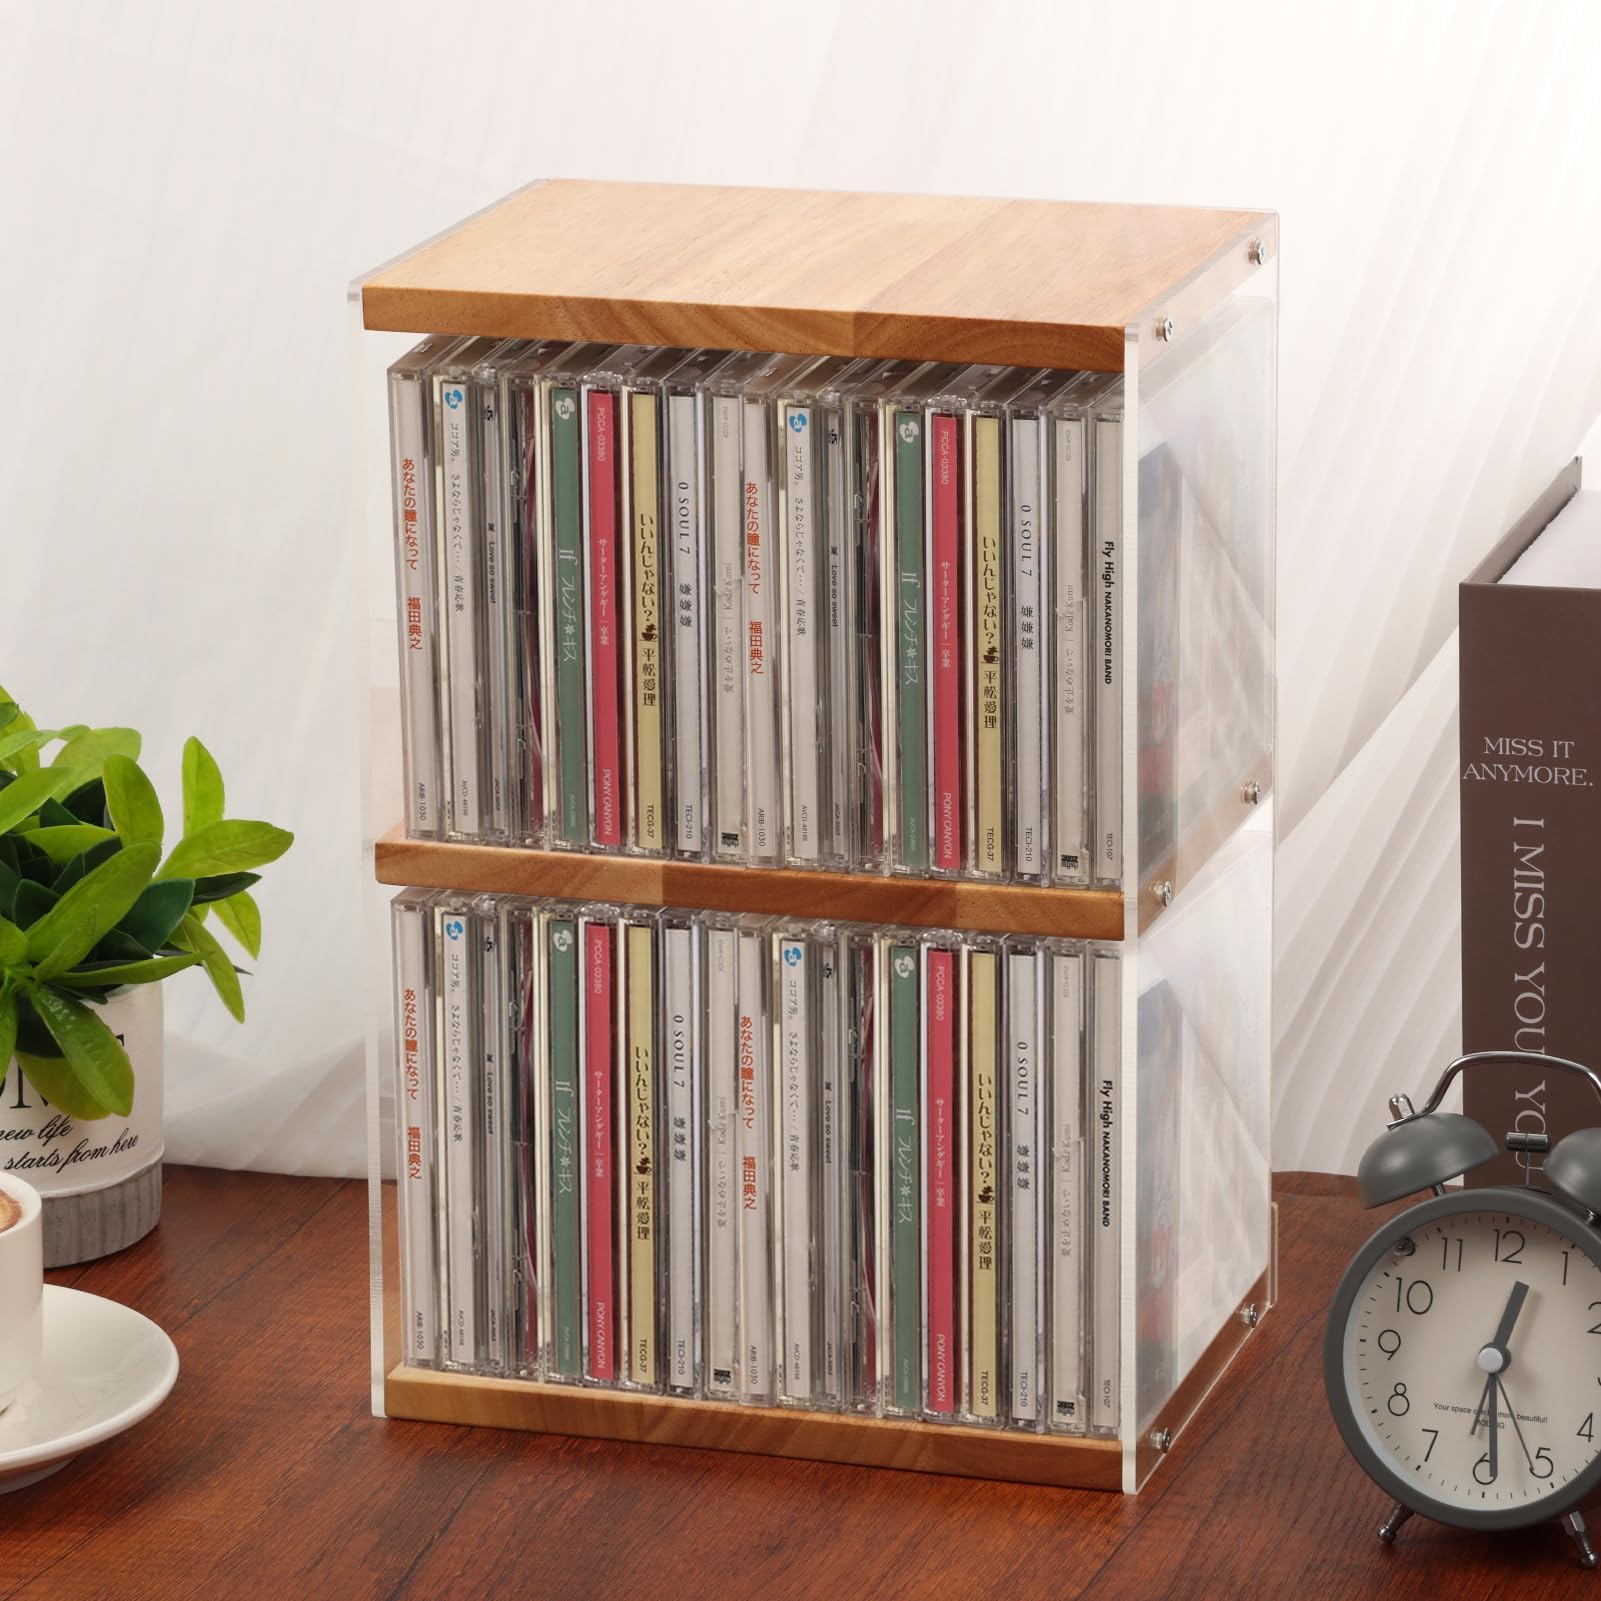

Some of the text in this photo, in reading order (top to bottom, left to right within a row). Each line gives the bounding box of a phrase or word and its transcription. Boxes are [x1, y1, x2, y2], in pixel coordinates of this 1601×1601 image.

[940, 431, 950, 486] PCCA-03380
[679, 497, 690, 540] SOUL
[559, 549, 578, 566] If
[679, 547, 690, 555] 7
[1021, 520, 1032, 562] SOUL
[745, 482, 764, 675] あなたの瞳になって 福田典之
[831, 565, 839, 587] Love
[902, 572, 920, 588] If
[1021, 569, 1032, 577] 7
[831, 588, 839, 599] so
[831, 601, 839, 628] sweet
[1101, 541, 1115, 685] Fly High NAKANOMORI BAND
[983, 671, 997, 729] 平松愛理
[1483, 736, 1575, 758] MISS IT
[1462, 763, 1594, 787] ANYMORE.
[602, 768, 613, 836] PONY CANYON
[646, 804, 655, 839] TECG-37
[757, 808, 766, 847] ARIB-1030
[943, 792, 953, 860] PONY CANYON
[1513, 816, 1544, 828] I
[986, 827, 995, 862] TECG-37
[1025, 826, 1033, 863] TECI-210
[1513, 842, 1545, 949] MISS
[1514, 961, 1546, 1055] YOU
[673, 1030, 684, 1072] SOUL
[556, 1081, 574, 1097] If
[674, 1080, 685, 1088] 7
[1017, 1057, 1029, 1100] SOUL
[896, 1109, 915, 1125] If
[1018, 1107, 1029, 1116] 7
[38, 1114, 73, 1147] life
[4, 1148, 62, 1171] starts
[56, 1138, 110, 1174] from
[1100, 1080, 1113, 1227] Fly High NAKANOMORI BAND
[1441, 1236, 1464, 1272] 11
[1493, 1229, 1525, 1264] 12
[1561, 1251, 1569, 1286] 1
[1396, 1277, 1434, 1316] 10
[1587, 1301, 1601, 1334] 2
[596, 1302, 607, 1369] PONY CANYON
[1378, 1329, 1402, 1361] 9
[936, 1333, 946, 1403] PONY CANYON
[1387, 1382, 1410, 1417] 8
[1433, 1402, 1450, 1411] Your
[1451, 1406, 1472, 1415] space
[1421, 1428, 1439, 1462] 7
[1576, 1412, 1594, 1443] 4
[1472, 1452, 1497, 1485] 6
[1529, 1446, 1554, 1479] 5
